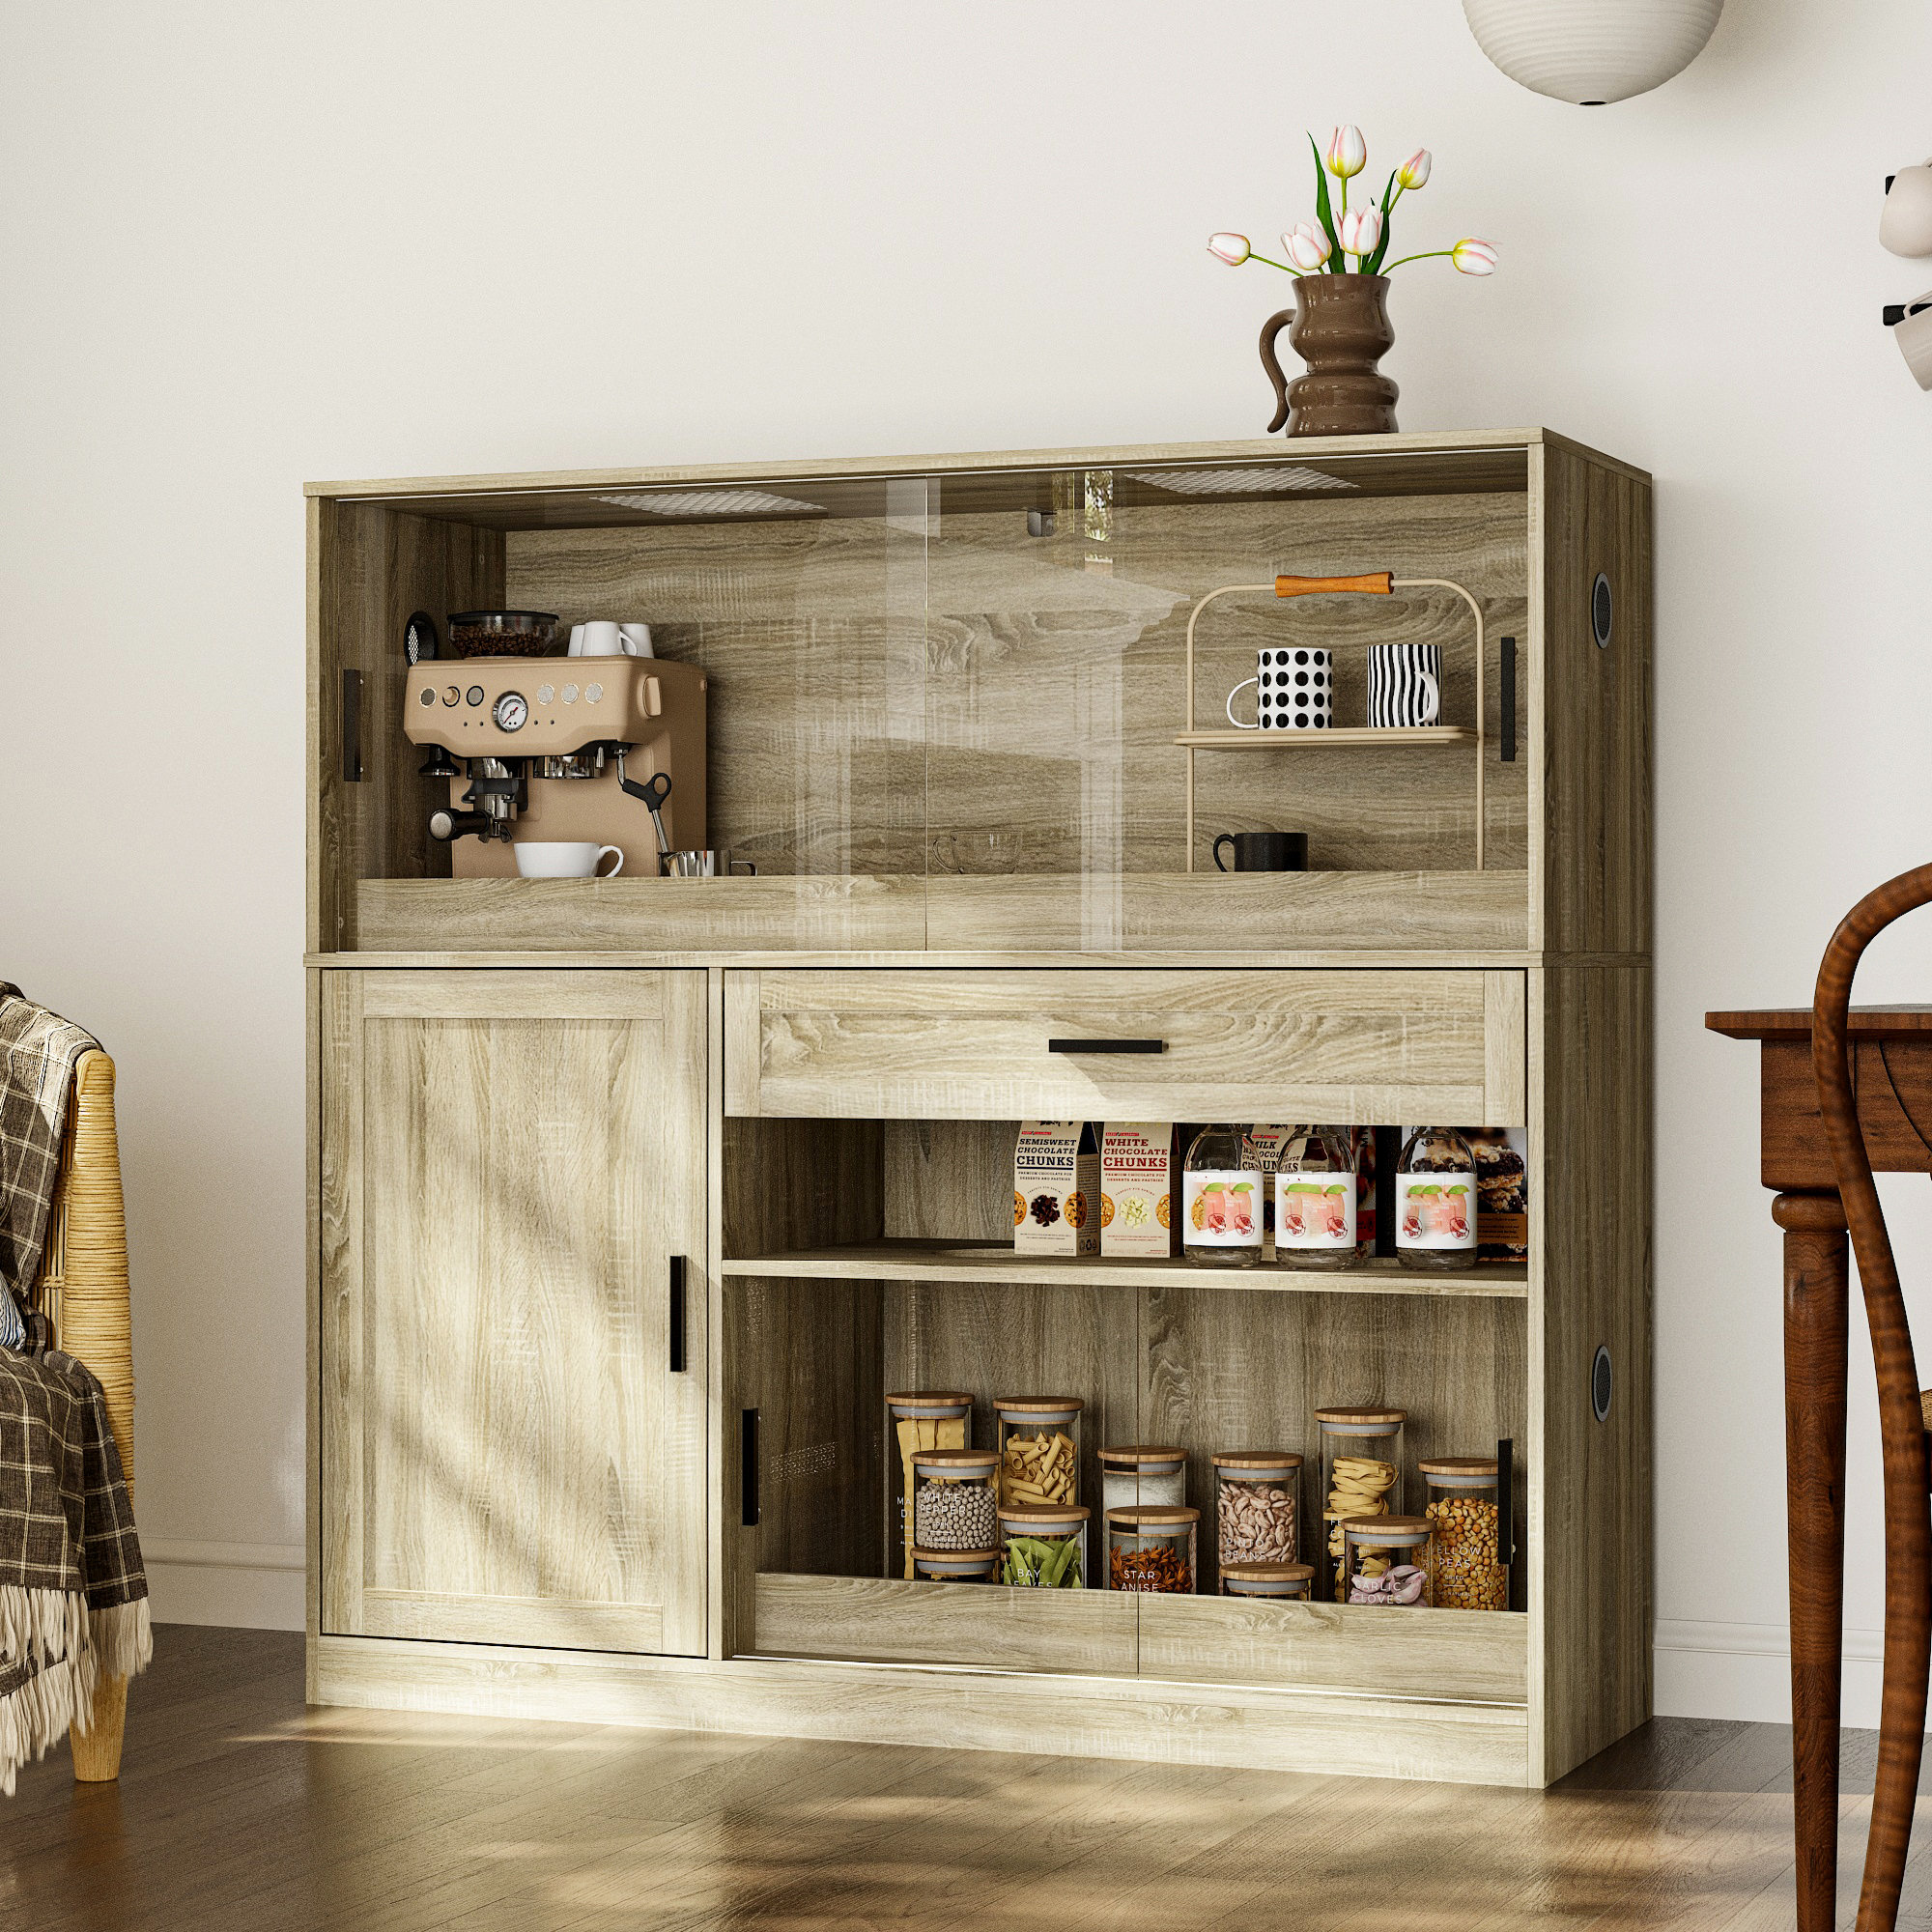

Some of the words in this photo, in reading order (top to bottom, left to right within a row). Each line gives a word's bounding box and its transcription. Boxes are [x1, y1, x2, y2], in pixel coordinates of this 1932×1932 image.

[1016, 1155, 1074, 1167] CHUNKS
[1103, 1156, 1168, 1167] CHUNKS
[923, 1492, 961, 1502] WHITE
[920, 1504, 967, 1515] PEPPER
[1226, 1537, 1264, 1548] PINTO
[1225, 1549, 1266, 1561] BEANS
[1438, 1557, 1471, 1569] PEAS
[1017, 1568, 1041, 1578] BAY
[1123, 1569, 1155, 1579] STAR
[1121, 1582, 1159, 1592] ANISE
[1353, 1593, 1403, 1605] CLOVES
